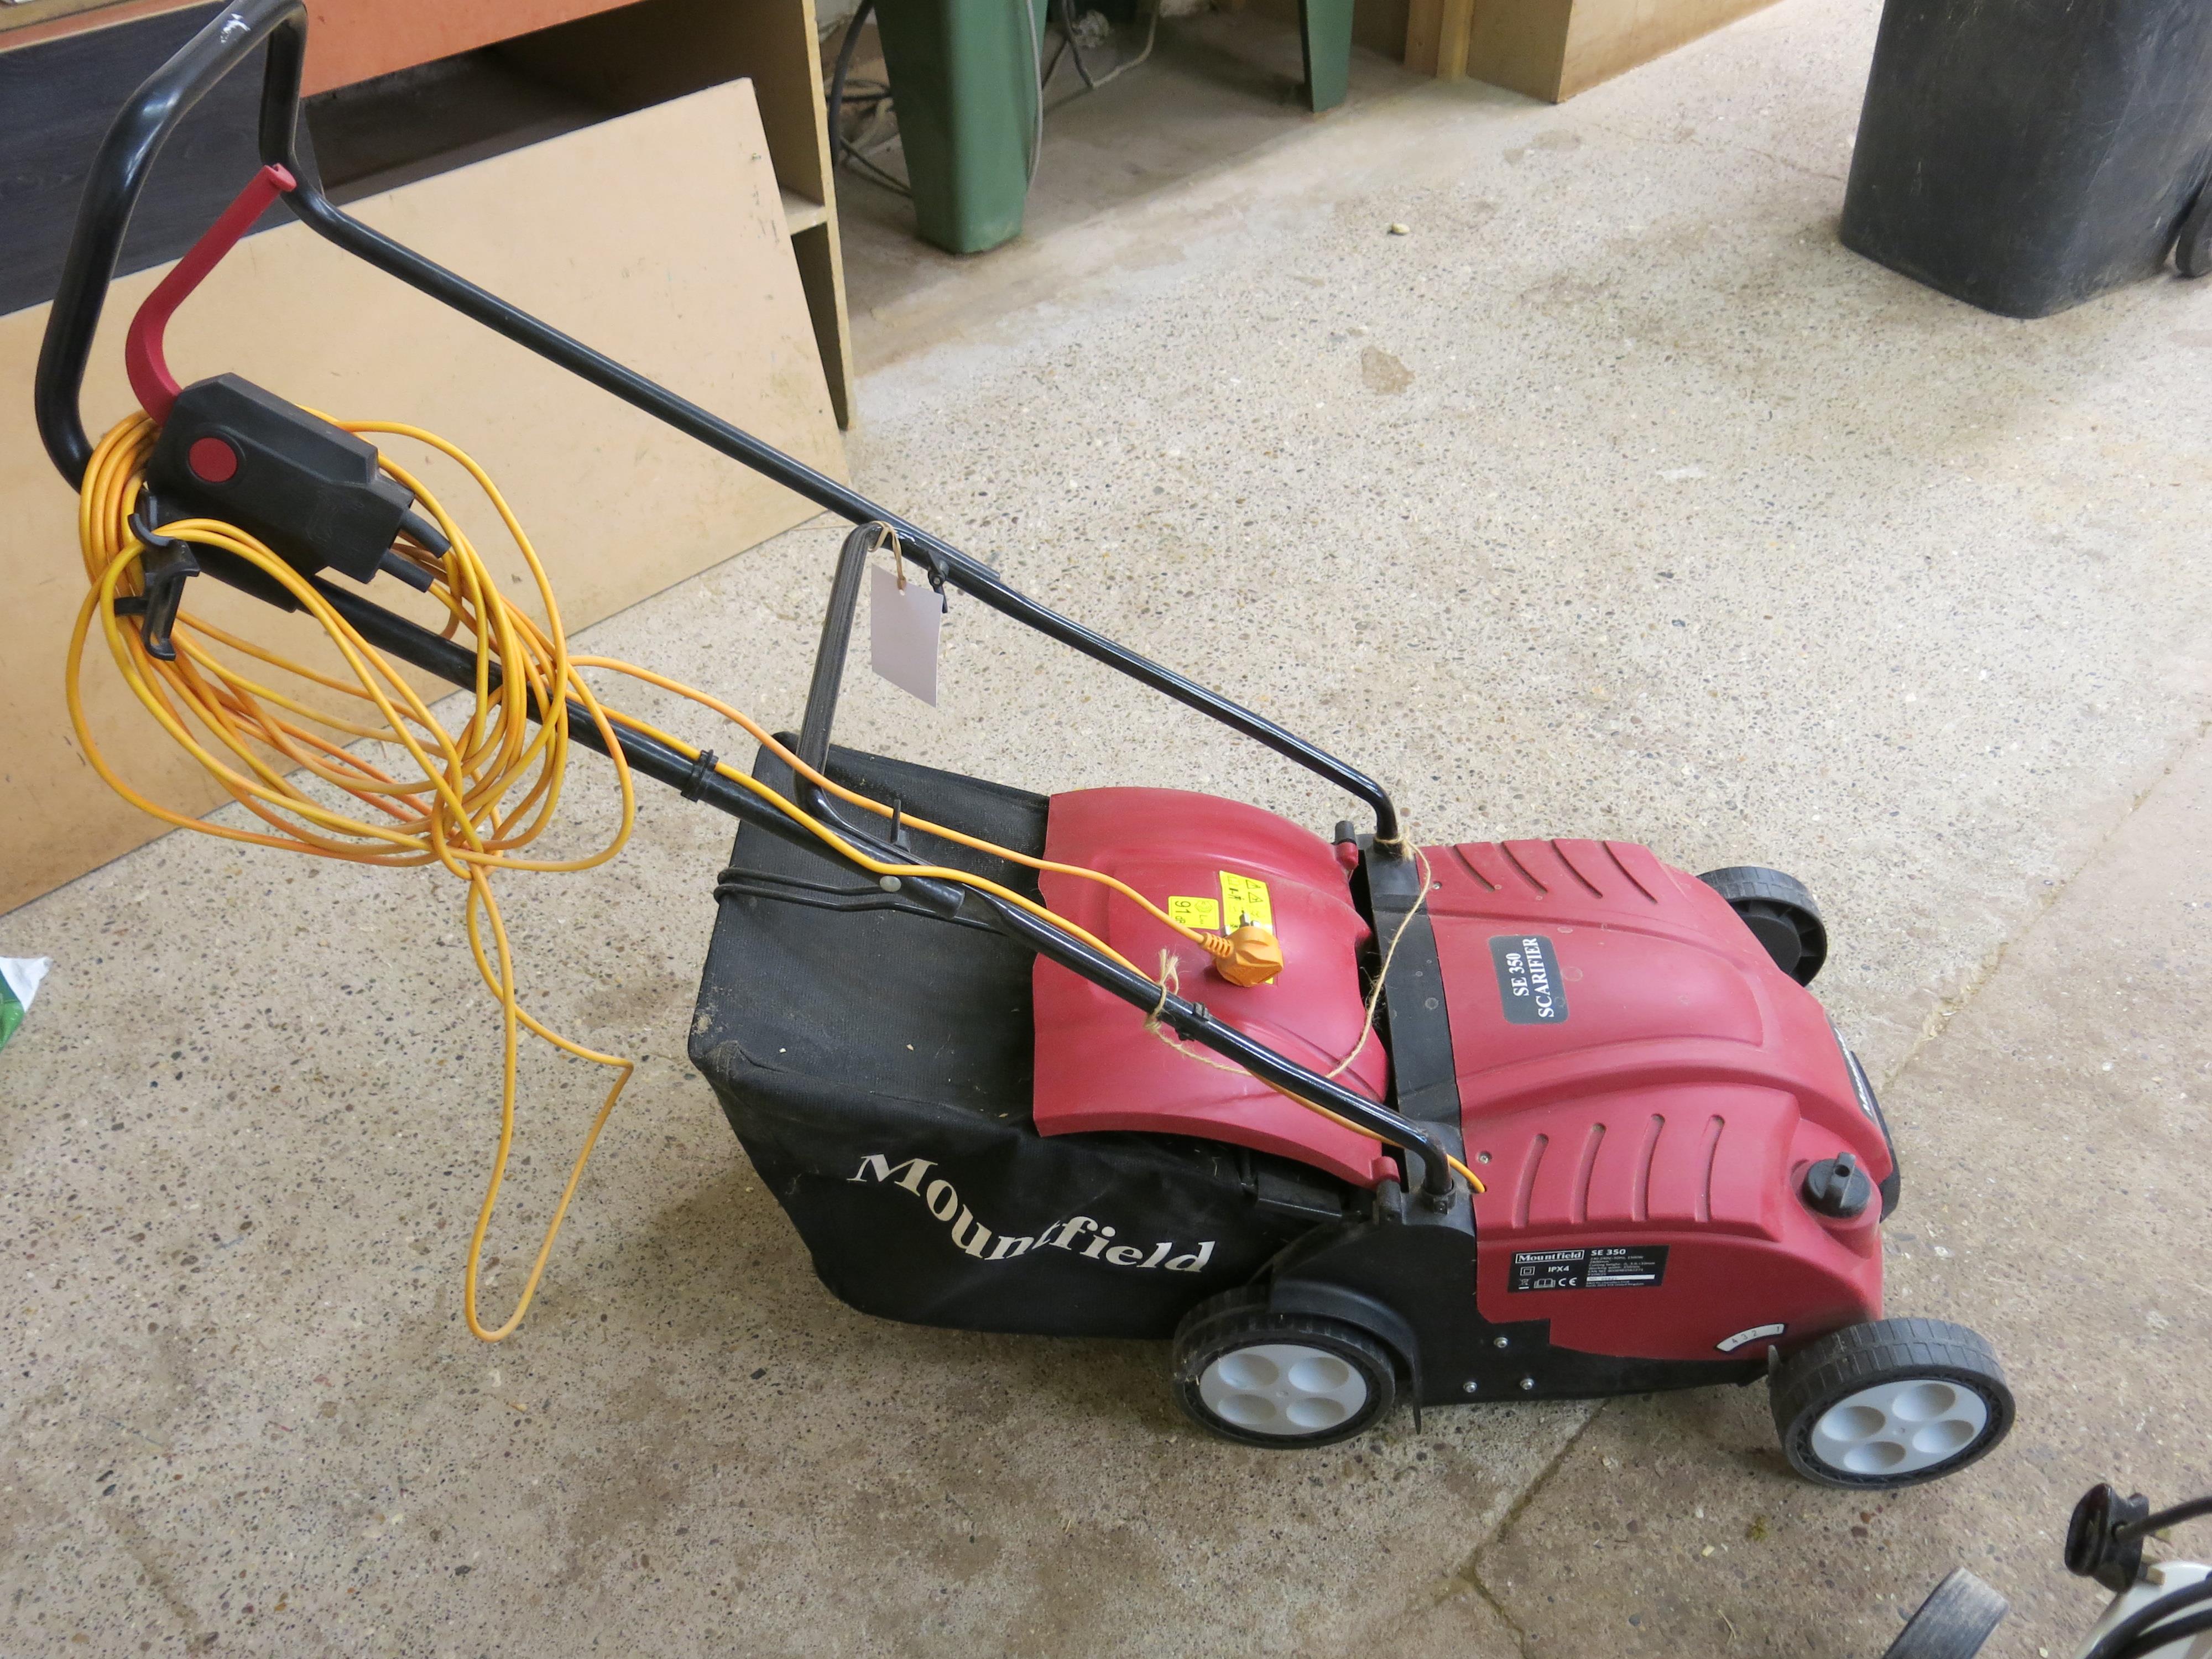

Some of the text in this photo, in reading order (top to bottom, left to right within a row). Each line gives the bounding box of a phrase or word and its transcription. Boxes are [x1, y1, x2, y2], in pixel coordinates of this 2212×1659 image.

[1175, 901, 1191, 914] 91
[1505, 953, 1530, 997] SE 350
[1522, 938, 1554, 1018] SCARIFIER
[846, 1154, 1215, 1272] Mountfield
[1518, 1251, 1582, 1262] Mountfield
